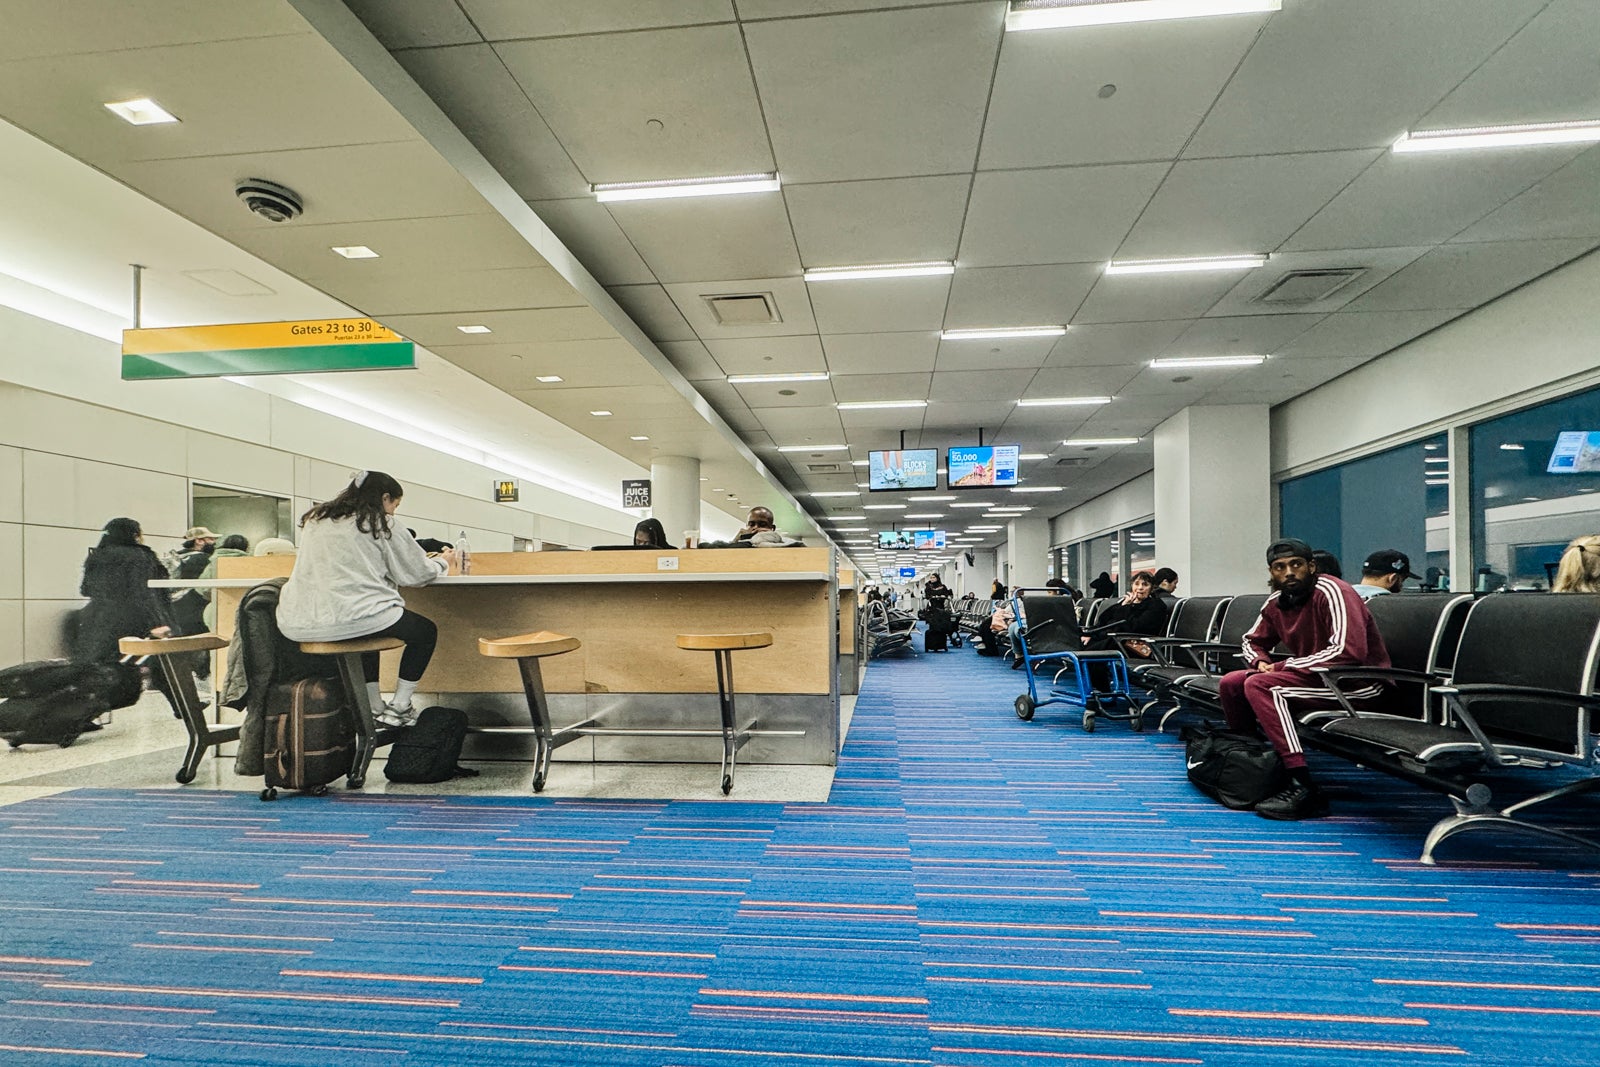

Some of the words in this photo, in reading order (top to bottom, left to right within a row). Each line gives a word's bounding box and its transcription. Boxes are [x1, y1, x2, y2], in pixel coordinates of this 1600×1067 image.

[291, 324, 323, 335] Gates
[326, 323, 339, 334] 23
[343, 323, 355, 333] to
[358, 322, 371, 332] 30
[952, 454, 977, 463] 50,000
[903, 460, 927, 469] BLOCKS
[624, 487, 649, 496] JUICE
[625, 495, 649, 507] BAR
